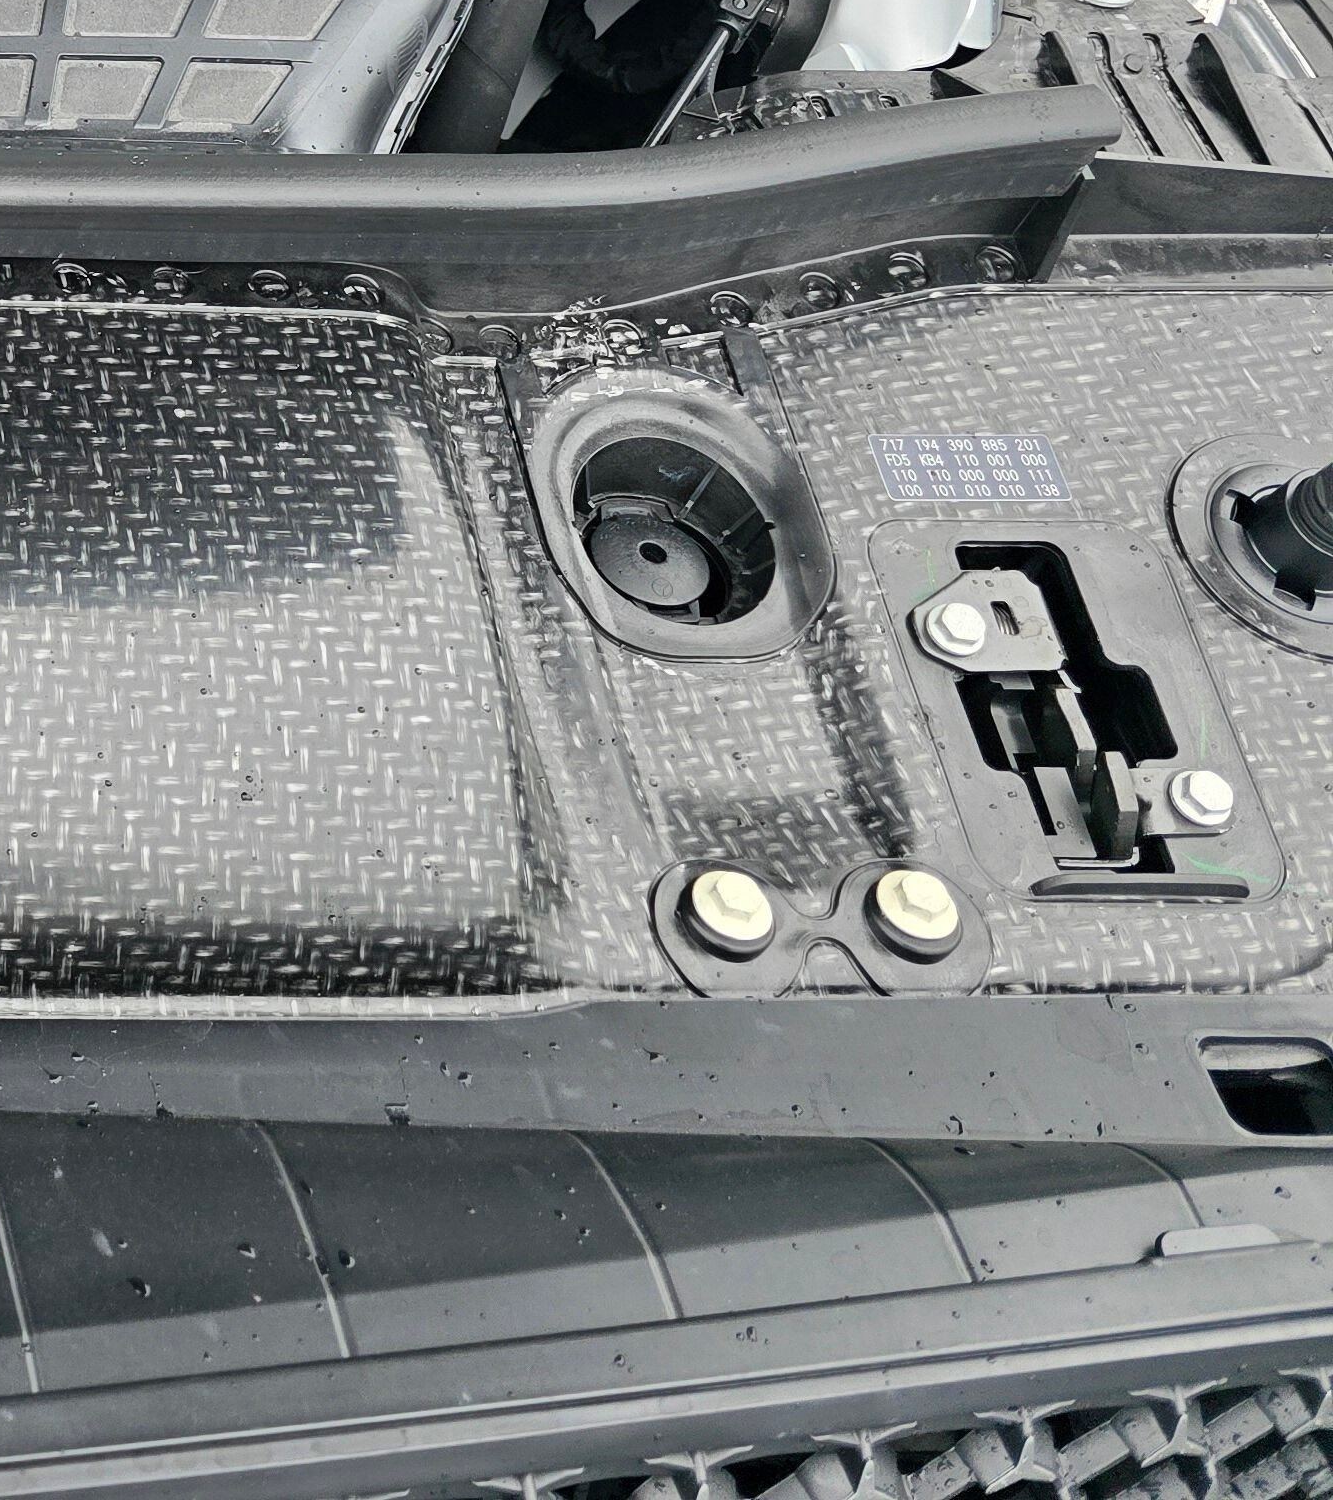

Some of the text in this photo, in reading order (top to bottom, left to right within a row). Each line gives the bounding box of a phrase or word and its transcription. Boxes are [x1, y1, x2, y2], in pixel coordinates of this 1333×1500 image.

[878, 439, 1041, 453] 717 194 390 885 201
[885, 454, 1048, 468] FD5 KB4 110 001 000
[891, 470, 1053, 483] 110 110 000 000 111
[897, 485, 1060, 498] 100 101 010 010 138
